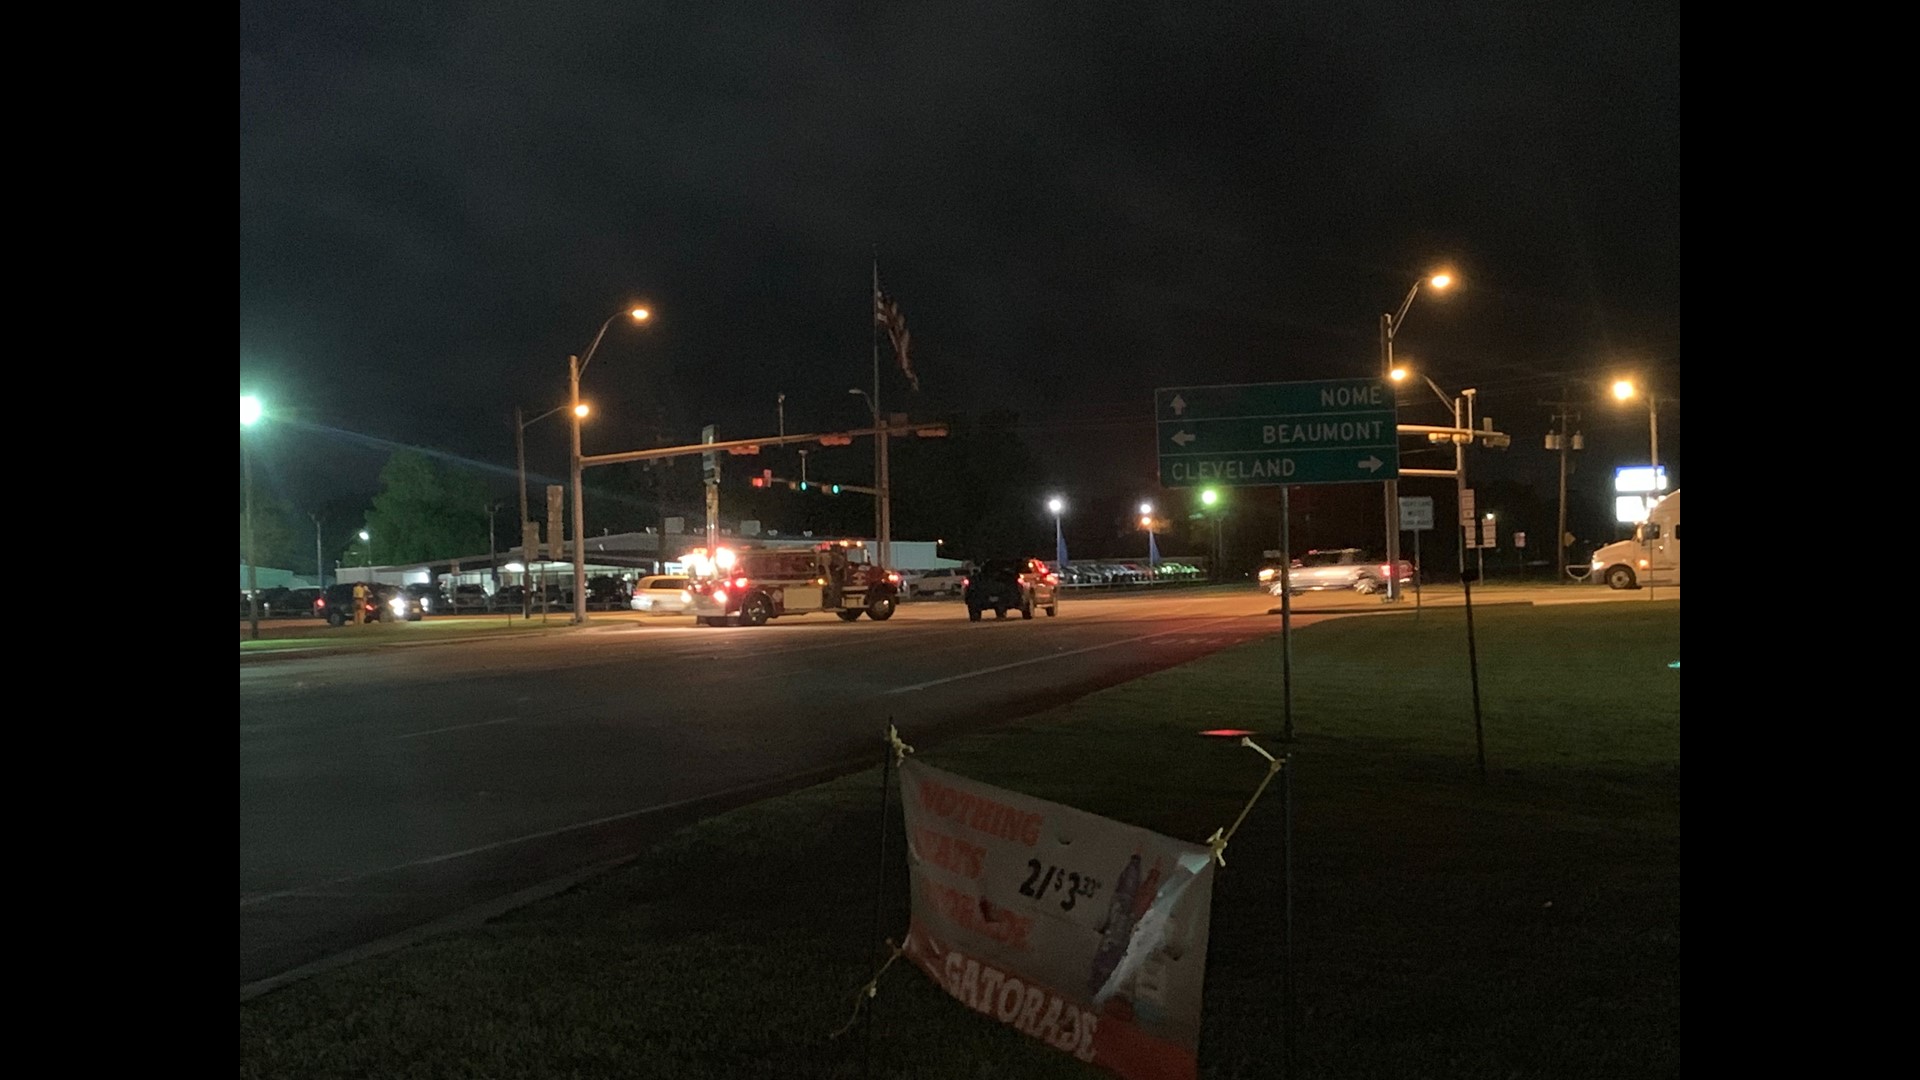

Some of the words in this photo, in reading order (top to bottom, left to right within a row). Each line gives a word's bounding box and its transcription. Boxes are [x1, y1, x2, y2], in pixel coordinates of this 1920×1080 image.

[1321, 386, 1383, 407] NOME
[1262, 421, 1384, 444] BEAUMONT
[1171, 458, 1296, 481] CLEVELAND
[920, 780, 1045, 846] NOTHING
[942, 952, 1098, 1063] GATORADE
